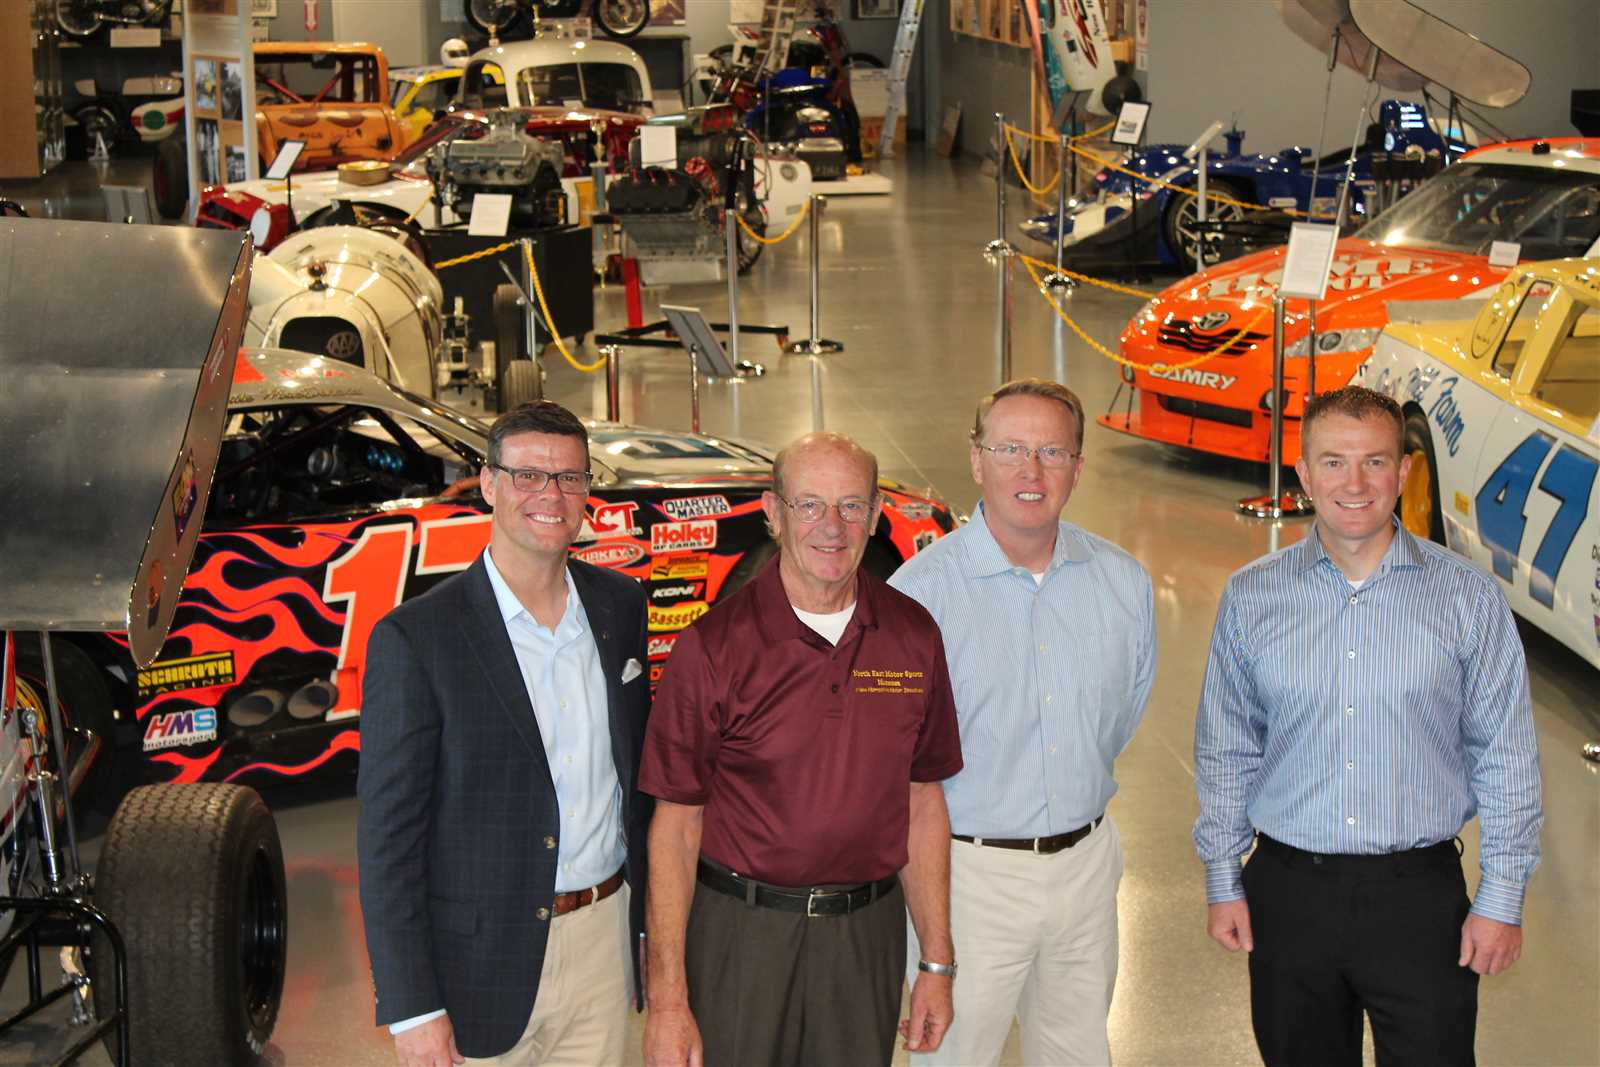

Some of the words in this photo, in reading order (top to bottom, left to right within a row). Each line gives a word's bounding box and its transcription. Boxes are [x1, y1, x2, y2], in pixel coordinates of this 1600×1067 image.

[1149, 362, 1238, 390] CAMRY
[664, 496, 725, 514] QUARTER
[677, 504, 732, 519] MASTER
[1475, 428, 1600, 611] 47
[653, 521, 716, 548] Holley
[652, 585, 697, 598] KONI
[138, 659, 233, 688] SCHROTH
[144, 708, 216, 740] HMS
